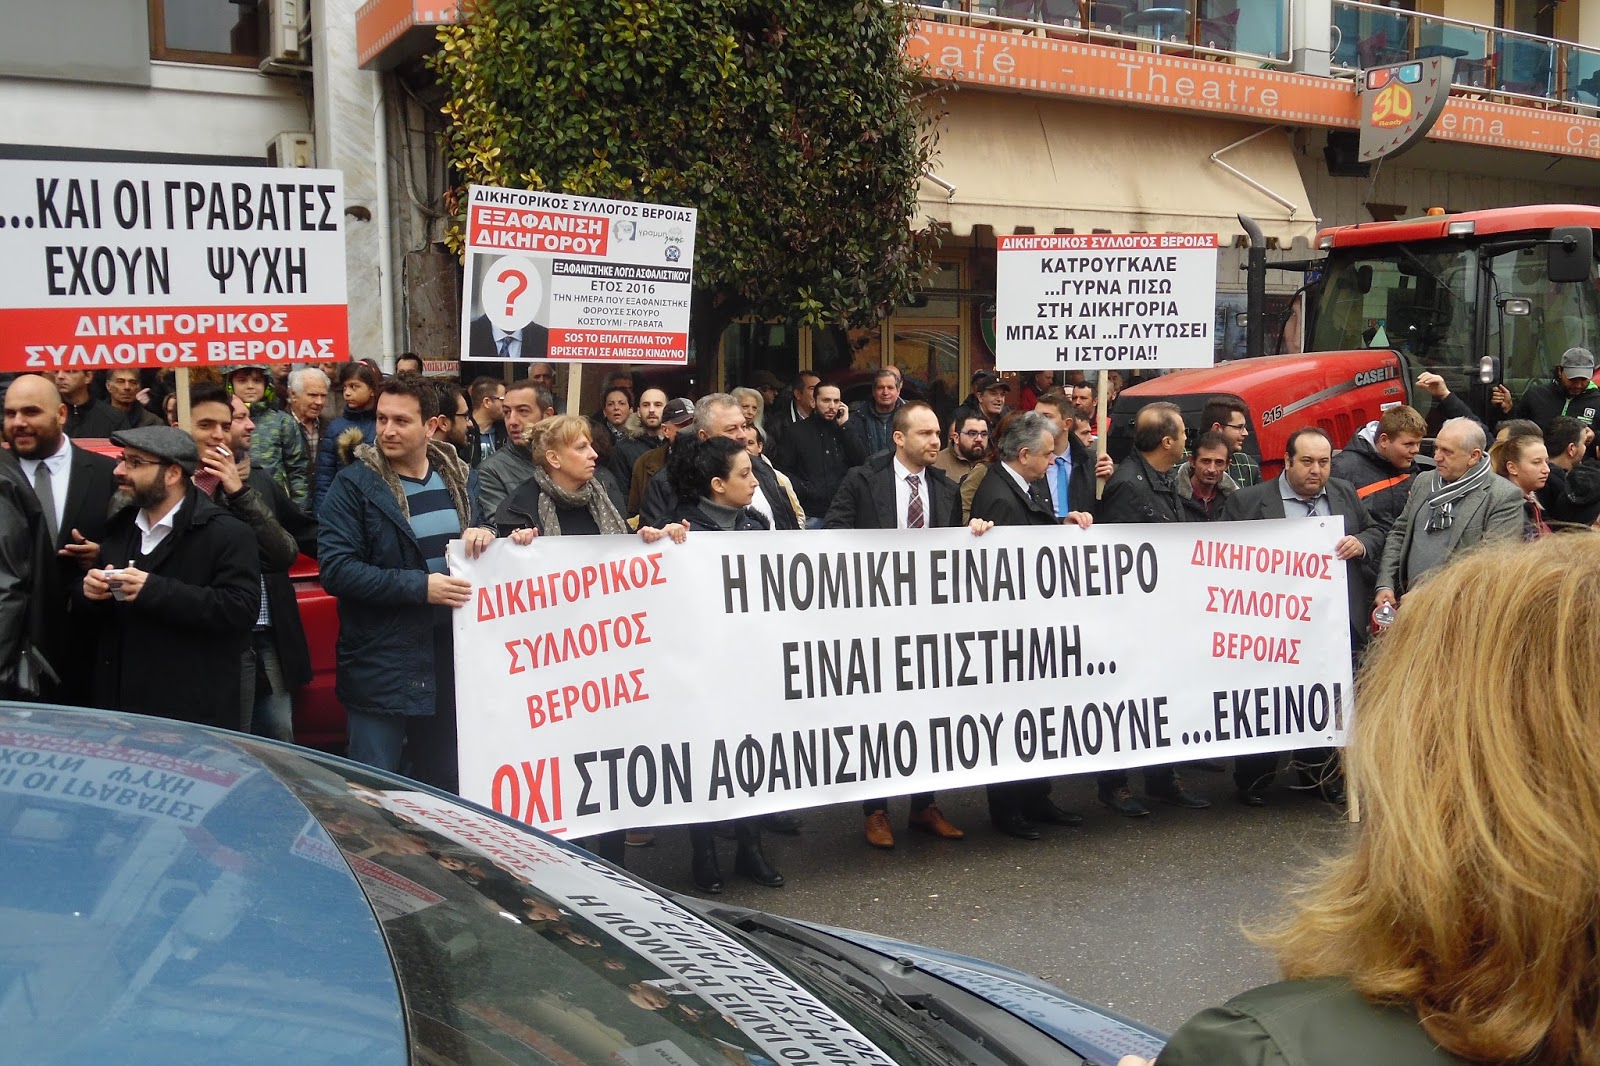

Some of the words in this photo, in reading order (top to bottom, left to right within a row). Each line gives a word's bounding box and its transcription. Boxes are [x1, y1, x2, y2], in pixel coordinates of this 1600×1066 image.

[1117, 62, 1279, 107] Theatre
[1372, 83, 1412, 121] 3D
[1379, 119, 1402, 127] Ready
[113, 179, 153, 231] ΟΙ
[164, 181, 337, 232] ΓΡΑΒΑΤΕΣ
[474, 190, 569, 210] ΔΙΚΗΓΟΡΙΚΟΣ
[573, 200, 638, 217] ΣΥΛΛΟΓΟΣ
[642, 207, 692, 222] ΒΕΡΟΙΑΣ
[477, 208, 603, 235] ΕΞΑΦΑΝΙΣΗ
[475, 229, 602, 254] ΔΙΚΗΓΟΡΟΥ
[1002, 236, 1087, 249] ΔΙΚΗΓΟΡΙΚΟΣ
[1091, 236, 1157, 248] ΣΥΛΛΟΓΟΣ
[1160, 235, 1213, 247] ΒΕΡΟΙΑΣ
[45, 246, 170, 296] ΕΧΟΥΝ
[206, 247, 308, 294] ΨΥΧΗ
[553, 262, 614, 276] ΕΞΑΦΑΝΙΣΤΗΚΕ
[614, 265, 635, 279] ΛΟΓΩ
[635, 267, 689, 281] ΑΣΦΑΛΙΣΤΙΚΟΥ
[1041, 256, 1177, 273] ΚΑΤΡΟΥΓΚΑΛΕ
[591, 280, 623, 293] ΕΤΟΣ
[626, 282, 655, 295] 2016
[1044, 279, 1122, 296] ...ΓΥΡΝΑ
[1128, 278, 1172, 295] ΠΙΣΩ
[553, 293, 572, 302] ΤΗΝ
[574, 294, 603, 304] ΗΜΕΡΑ
[606, 295, 625, 305] ΠΟΥ
[626, 297, 688, 308] ΕΞΑΦΑΝΙΣΤΗΚΕ
[583, 306, 624, 316] ΦΟΡΟΥΣΕ
[626, 308, 660, 317] ΣΚΟΥΡΟ
[1037, 303, 1073, 318] ΣΤΗ
[1078, 301, 1178, 317] ΔΙΚΗΓΟΡΙΑ
[74, 313, 288, 337] ΔΙΚΗΓΟΡΙΚΟΣ
[577, 317, 622, 327] ΚΟΣΤΟΥΜΙ
[628, 319, 663, 328] ΓΡΑΒΑΤΑ
[1006, 325, 1058, 341] ΜΠΑΣ
[1065, 324, 1096, 340] ΚΑΙ
[1102, 323, 1207, 339] ...ΓΛΥΤΩΣΕΙ
[564, 333, 584, 343] SOS
[585, 333, 599, 344] ΤΟ
[599, 334, 653, 345] ΕΠΑΓΓΕΛΜΑ
[654, 336, 673, 345] ΤΟΥ
[25, 342, 198, 367] ΣΥΛΛΟΓΟΣ
[207, 338, 335, 362] ΒΕΡΟΙΑΣ
[550, 345, 599, 356] ΒΡΙΣΚΕΤΑΙ
[599, 347, 611, 357] ΣΕ
[612, 347, 643, 358] ΑΜΕΣΟ
[645, 348, 685, 359] ΚΙΝΔΥΝΟ
[1056, 346, 1068, 362] Η
[1075, 345, 1158, 362] ΙΣΤΟΡΙΑ!!
[1354, 368, 1385, 386] CASE
[1262, 405, 1282, 427] 215
[1191, 539, 1333, 580] ΔΙΚΗΓΟΡΙΚΟΣ
[476, 552, 667, 623] ΔΙΚΗΓΟΡΙΚΟΣ
[720, 554, 749, 614] Η
[760, 550, 916, 612] ΝΟΜΙΚΗ
[930, 547, 1025, 605] ΕΙΝΑΙ
[1035, 541, 1158, 600] ΟΝΕΙΡΟ
[1205, 585, 1313, 622] ΣΥΛΛΟΓΟΣ
[504, 611, 652, 675] ΣΥΛΛΟΓΟΣ
[1212, 631, 1302, 665] ΒΕΡΟΙΑΣ
[782, 636, 881, 701] ΕΙΝΑΙ
[894, 624, 1117, 692] ΕΠΙΣΤΗΜΗ...
[526, 668, 649, 730] ΒΕΡΟΙΑΣ
[491, 756, 563, 825] ΟΧΙ
[573, 741, 693, 817] ΣΤΟΝ
[708, 719, 918, 801] ΑΦΑΝΙΣΜΟ
[929, 711, 1004, 774] ΠΟΥ
[1014, 696, 1171, 763] ΘΕΛΟΥΝΕ
[1181, 682, 1344, 744] ...ΕΚΕΙΝΟΙ
